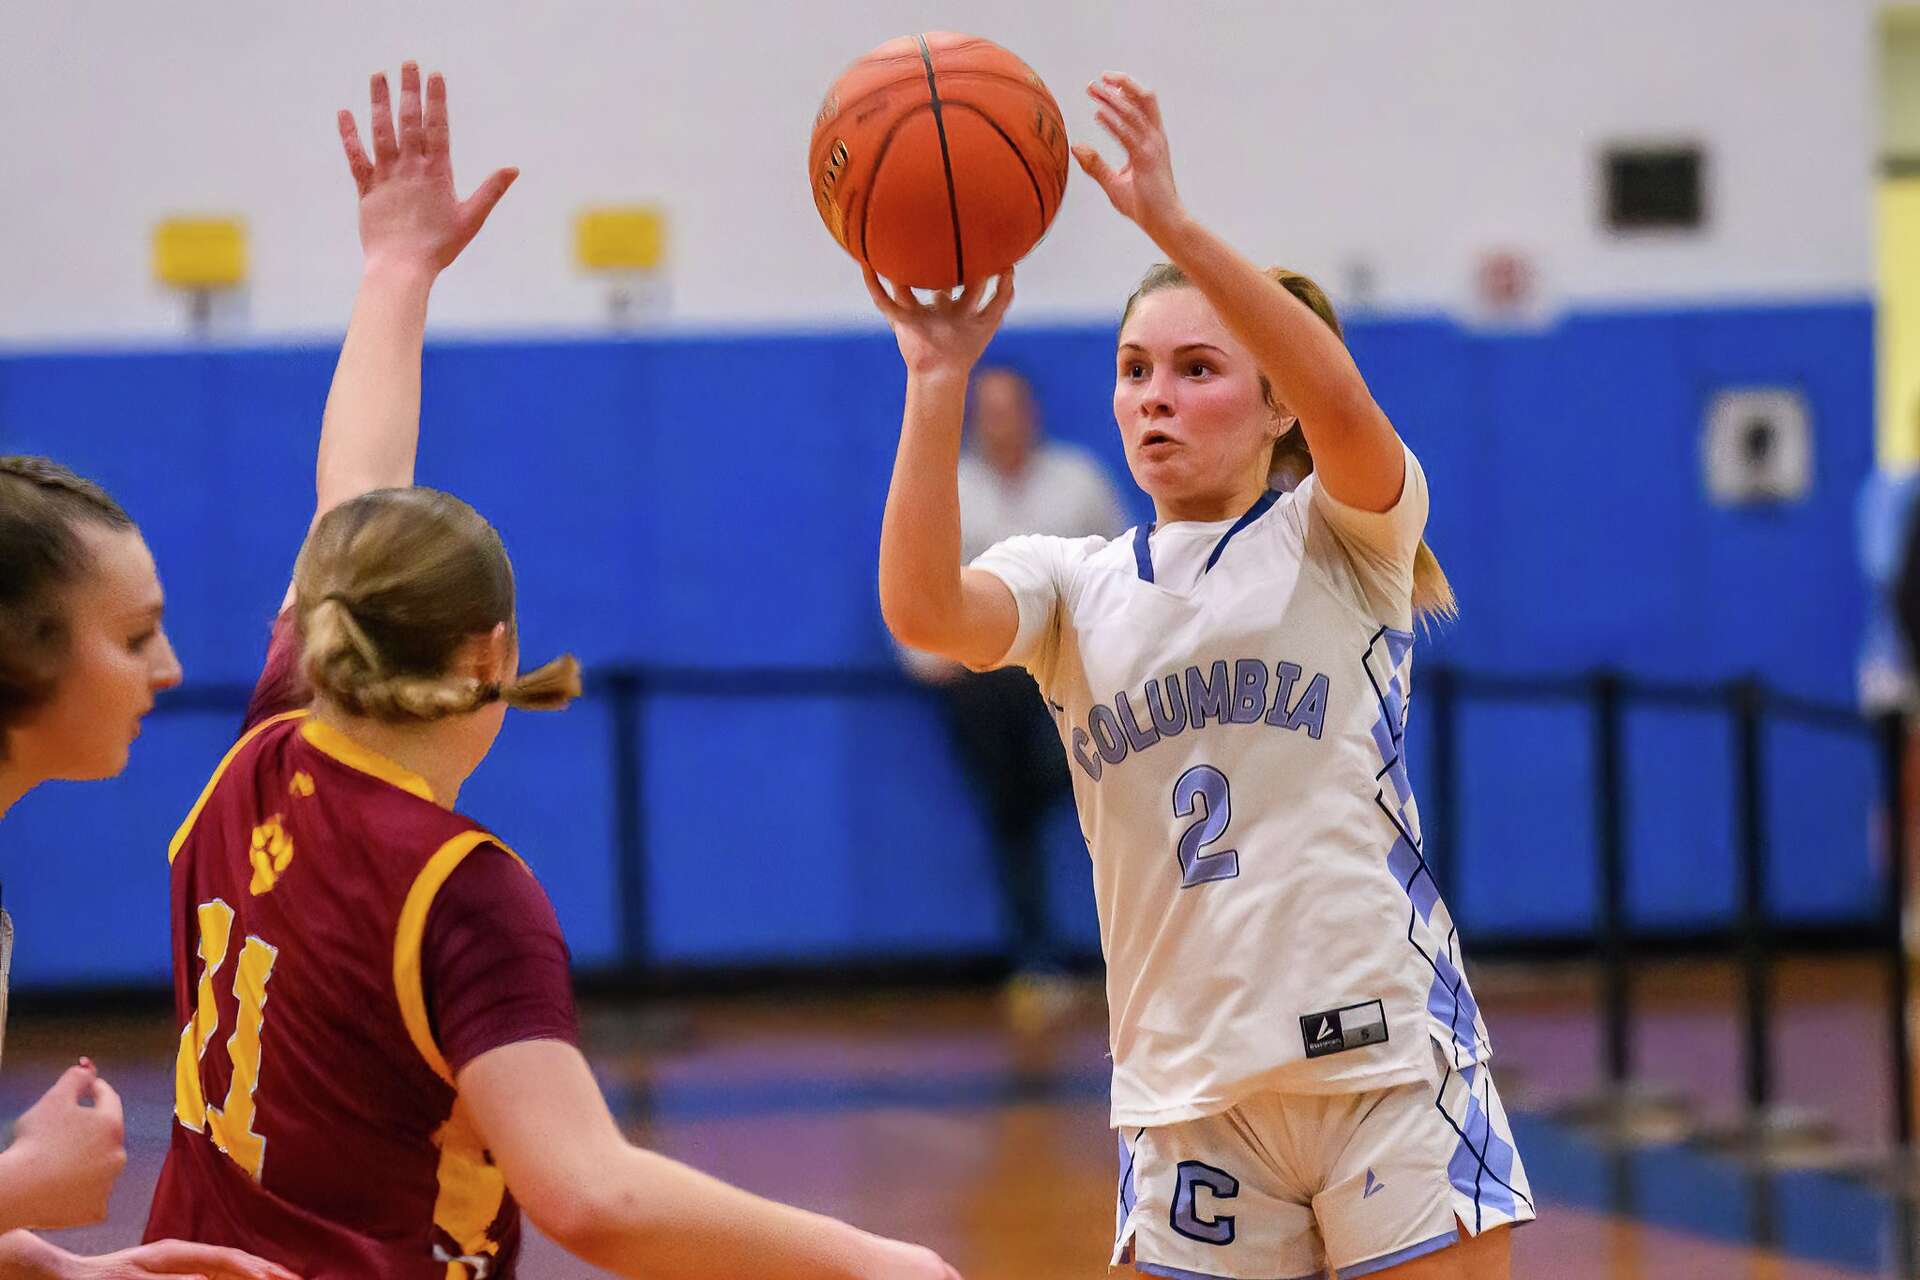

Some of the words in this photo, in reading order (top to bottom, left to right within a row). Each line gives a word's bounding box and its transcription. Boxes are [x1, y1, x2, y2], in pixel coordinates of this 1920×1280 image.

[1072, 659, 1329, 782] COLUMBIA
[1173, 764, 1239, 888] 2
[174, 898, 279, 1184] 11
[1170, 1160, 1239, 1245] C
